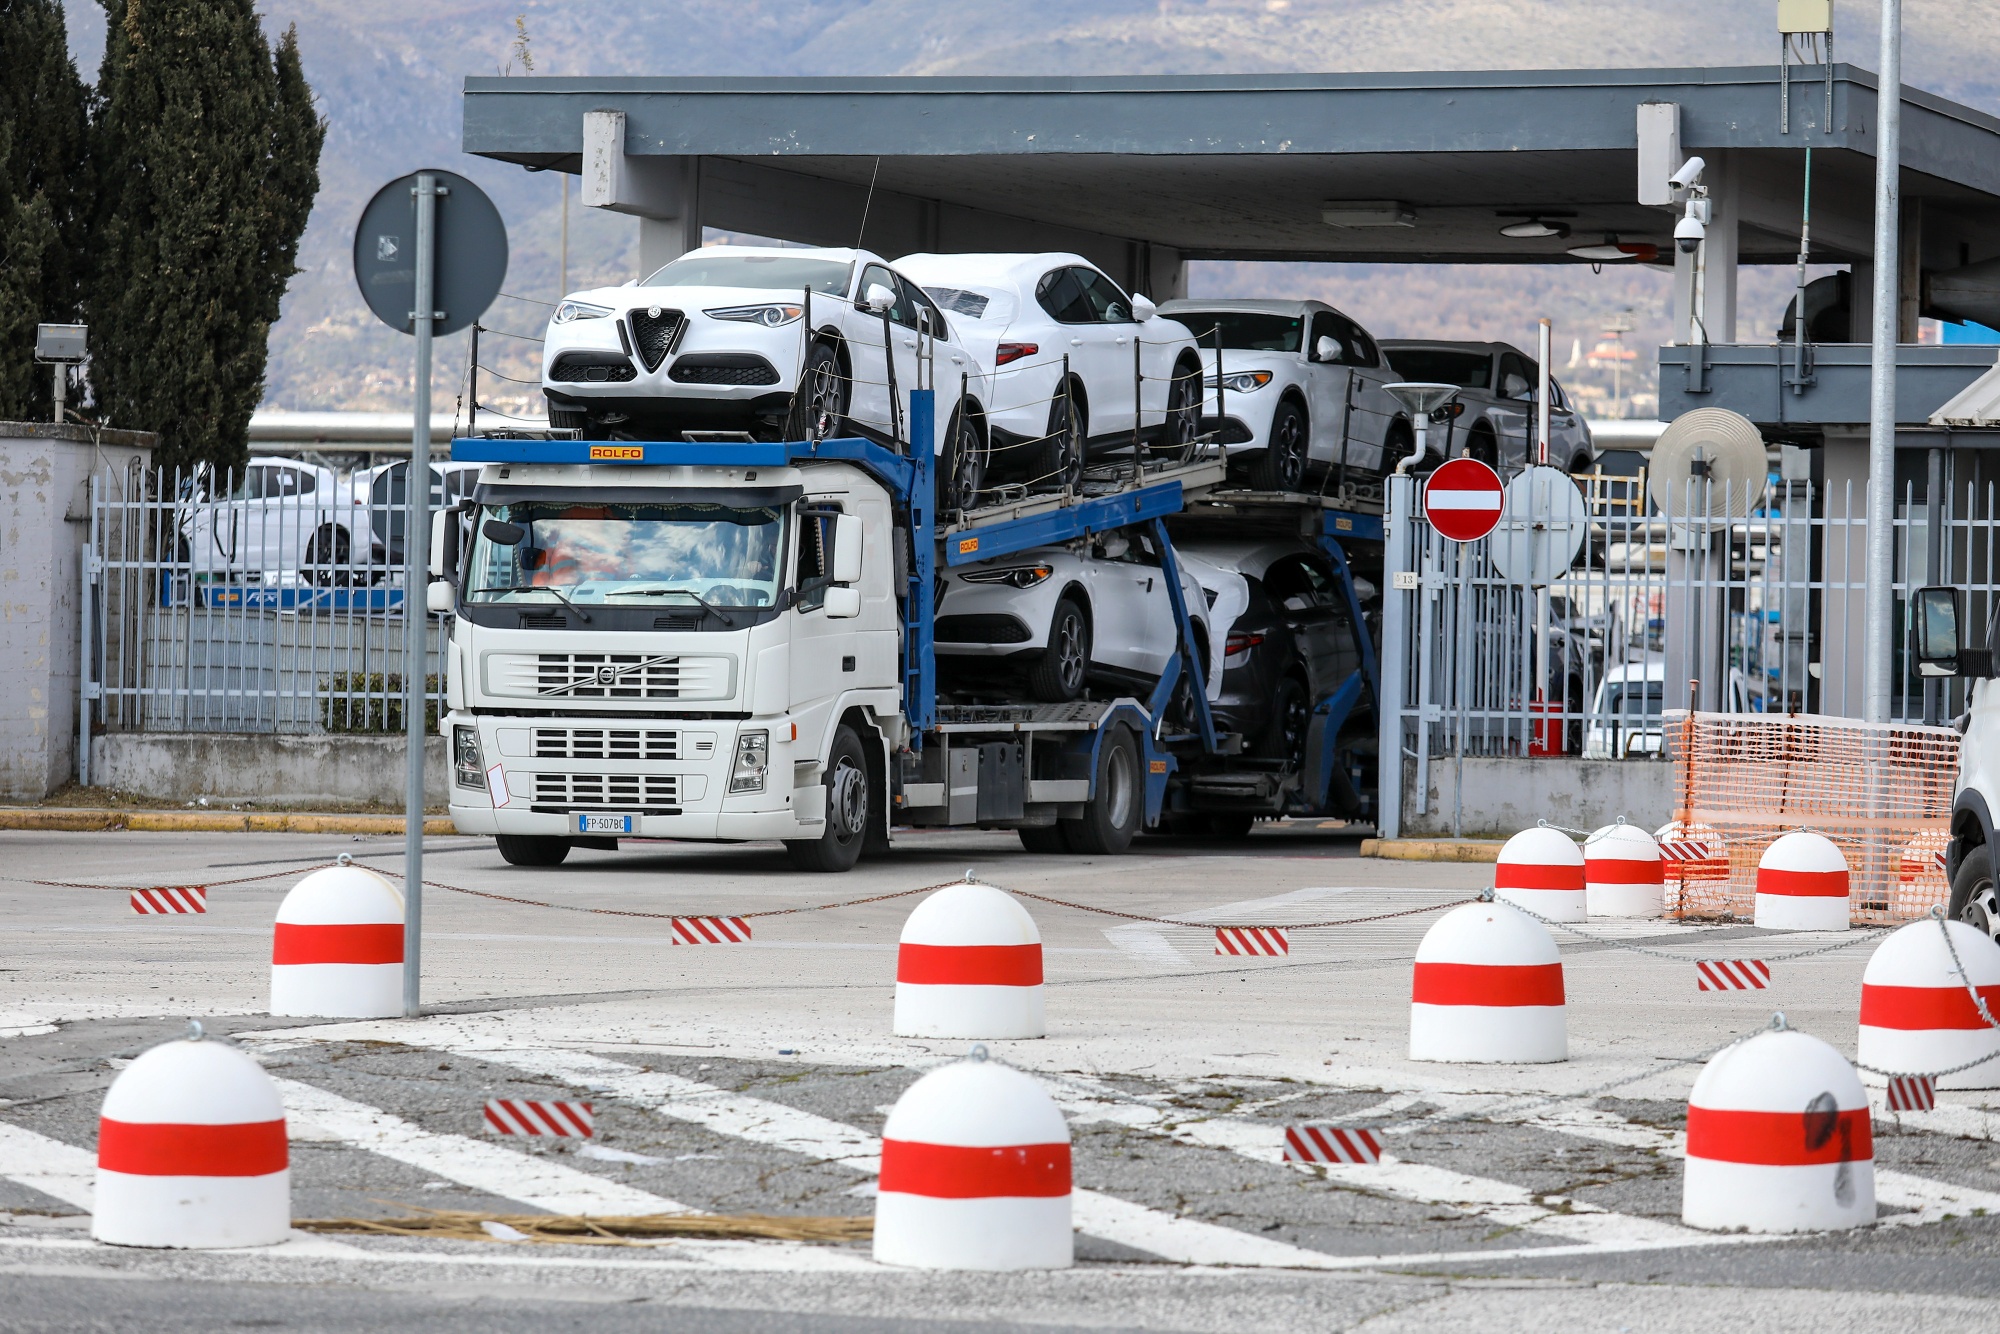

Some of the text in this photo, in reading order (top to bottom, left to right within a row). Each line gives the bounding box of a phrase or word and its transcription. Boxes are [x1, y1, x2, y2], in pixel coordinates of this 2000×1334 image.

[592, 449, 641, 457] ROLFO
[960, 540, 978, 551] ROLFO
[1402, 575, 1413, 584] 13
